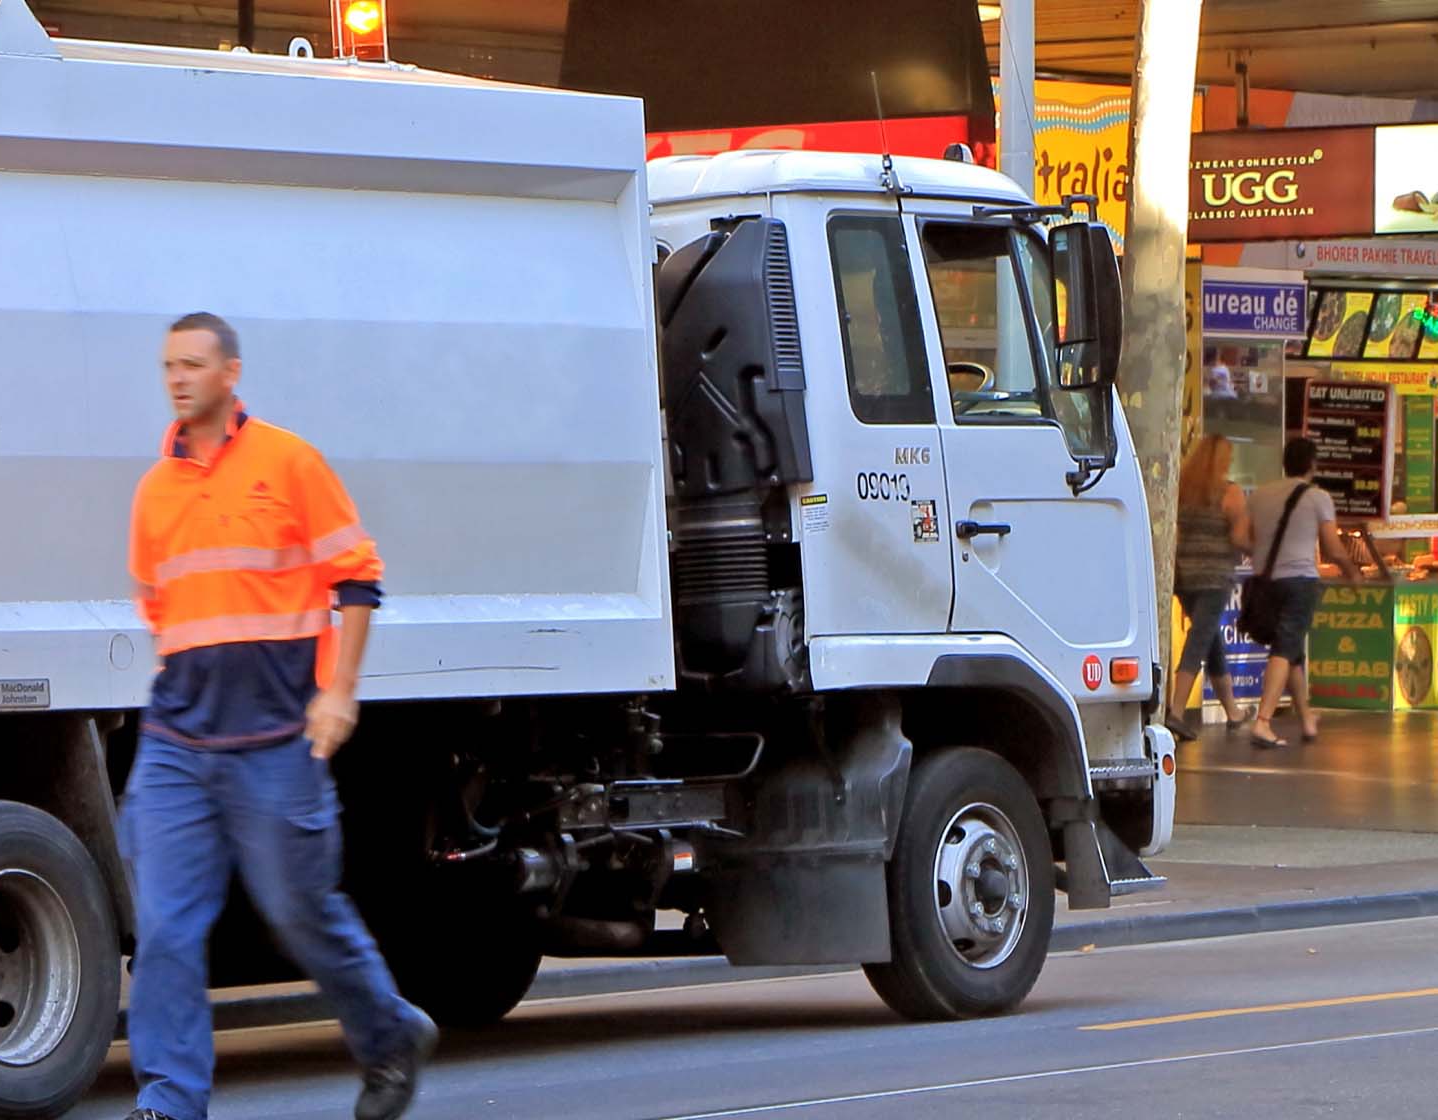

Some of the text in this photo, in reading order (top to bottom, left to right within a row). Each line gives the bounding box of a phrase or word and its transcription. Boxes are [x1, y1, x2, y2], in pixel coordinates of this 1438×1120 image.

[1237, 156, 1314, 168] CONNECTION
[1038, 146, 1129, 202] tralia
[1202, 170, 1298, 206] UGG
[1240, 207, 1314, 218] AUSTRALIAN
[1317, 246, 1359, 261] BHORER
[1204, 289, 1298, 316] ureau dé
[1254, 316, 1297, 330] CHANGE
[1309, 386, 1386, 402] EAT UNLIMITED
[895, 447, 930, 464] MK6
[1322, 587, 1387, 605] ASTY
[1312, 611, 1384, 629] PIZZA
[1086, 663, 1102, 682] UD
[1307, 660, 1390, 678] KEBAB
[1, 682, 44, 694] MacDonald
[1, 694, 38, 705] Johnston
